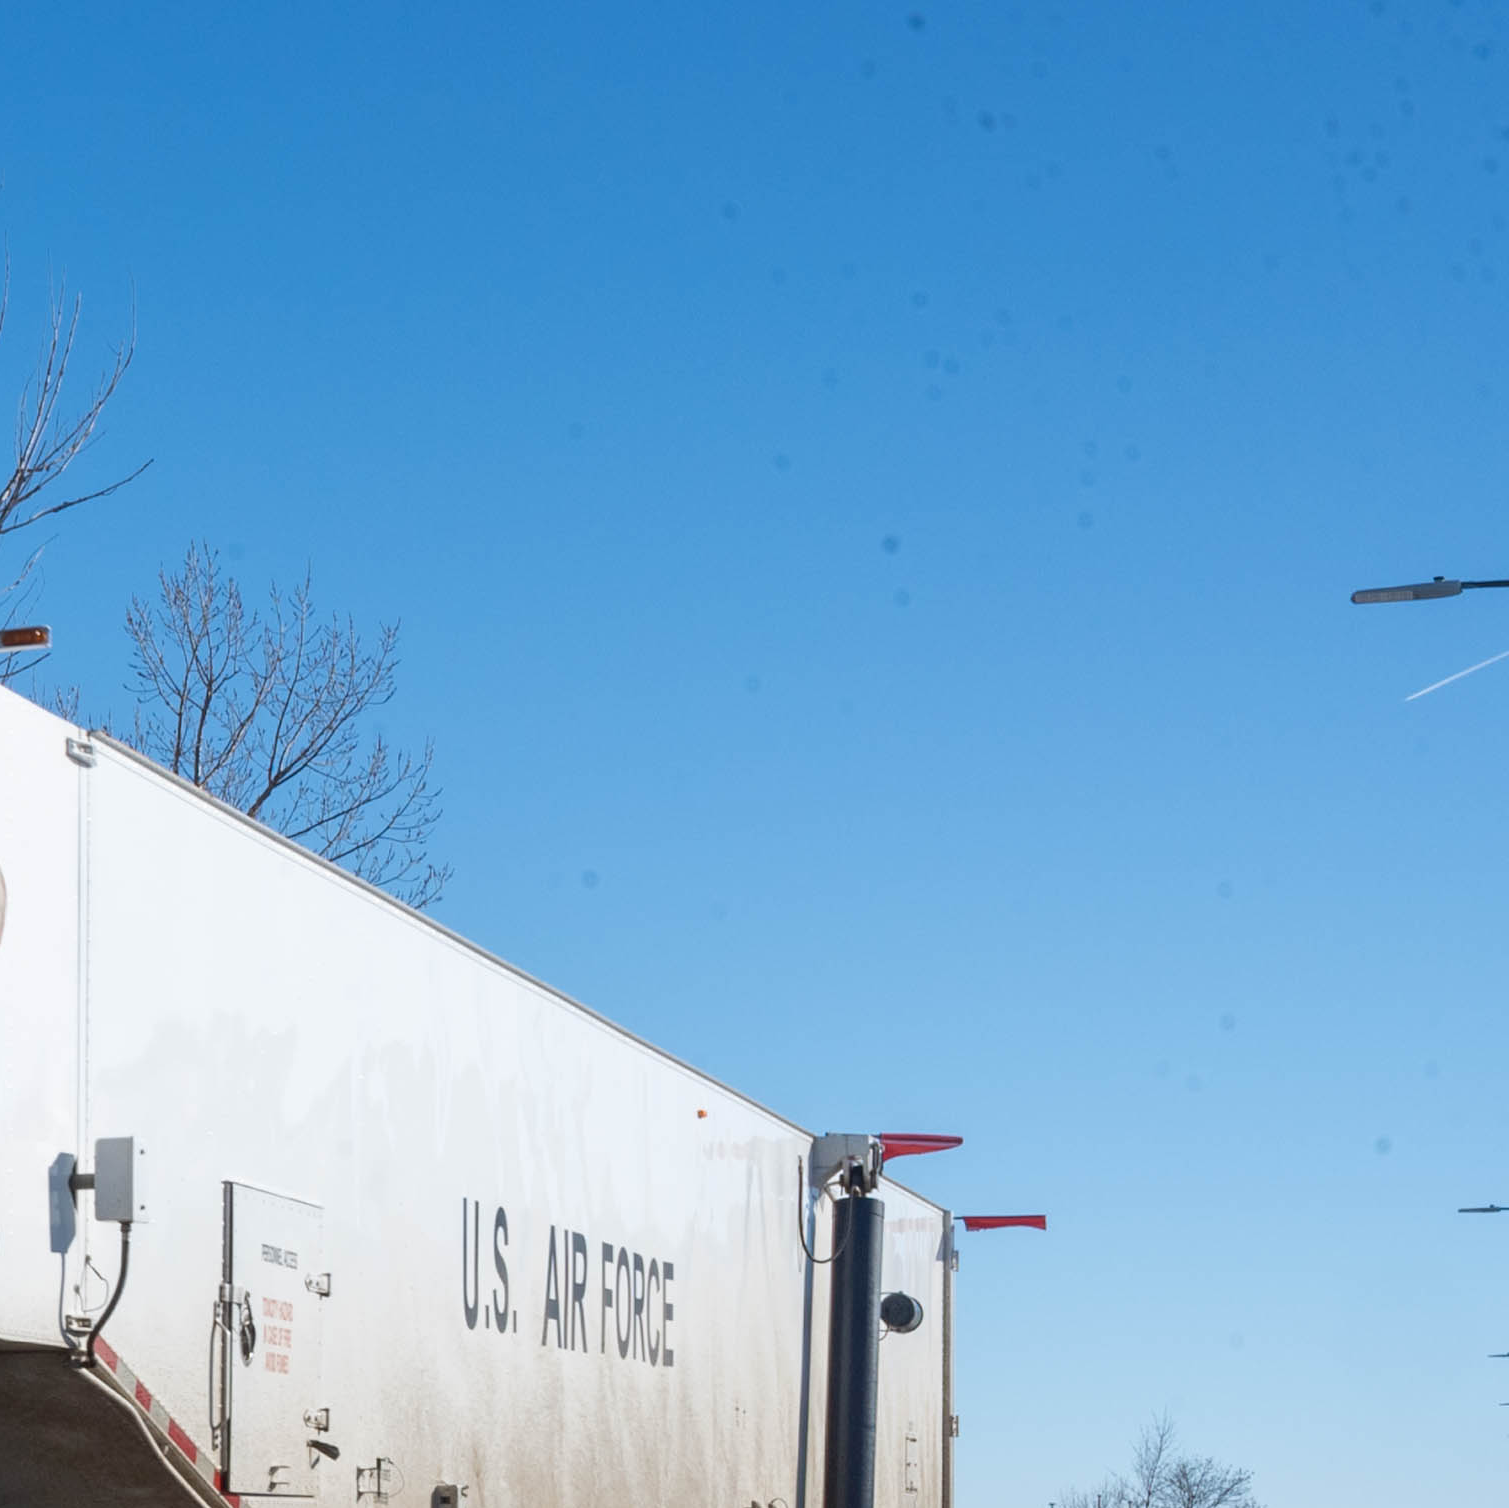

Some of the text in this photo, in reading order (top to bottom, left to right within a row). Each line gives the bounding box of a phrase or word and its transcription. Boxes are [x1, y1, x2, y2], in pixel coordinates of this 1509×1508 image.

[462, 1197, 675, 1368] U.S. AIR FORCE
